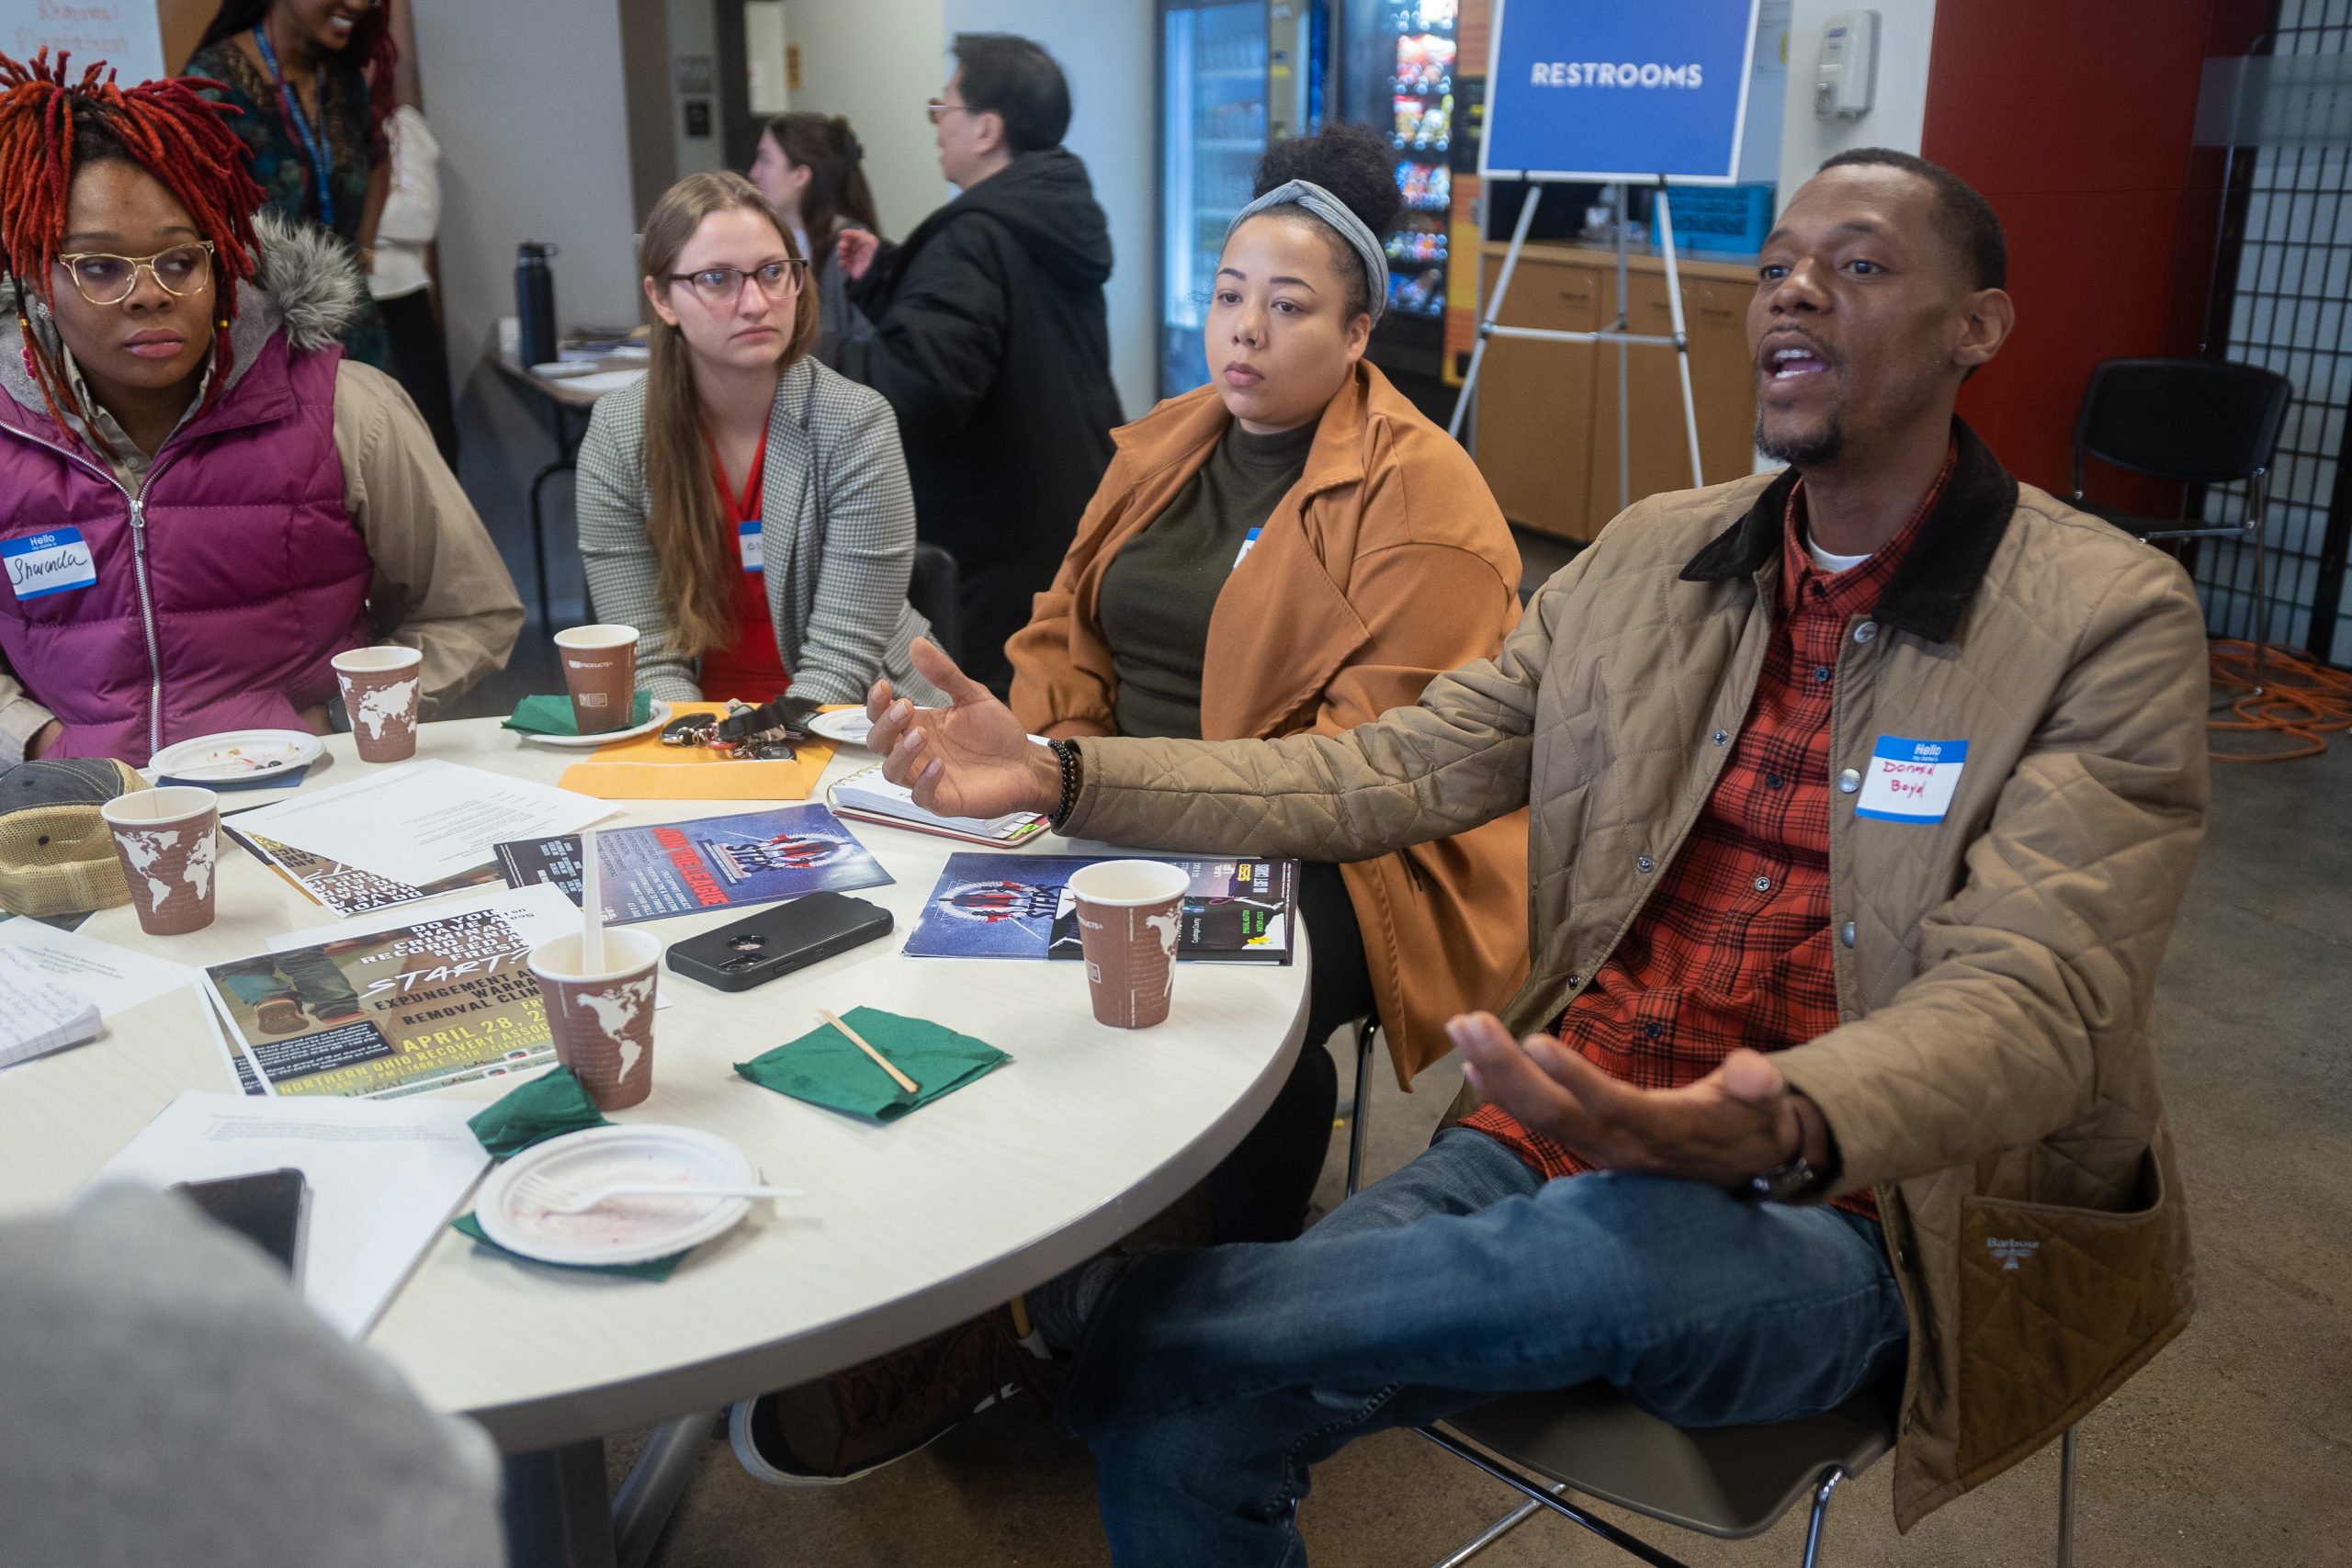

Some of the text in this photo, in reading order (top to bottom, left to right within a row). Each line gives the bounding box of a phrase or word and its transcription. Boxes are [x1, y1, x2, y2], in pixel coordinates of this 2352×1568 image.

[1530, 62, 1702, 88] RESTROOMS
[29, 535, 55, 547] Hello
[1914, 743, 1941, 756] Hello
[1891, 779, 1927, 798] Boyd
[652, 828, 688, 849] JOIN
[668, 847, 706, 869] THE
[391, 889, 424, 901] DO
[680, 866, 731, 907] LEAGUE
[410, 920, 444, 933] DO
[454, 908, 499, 924] YOU
[415, 915, 504, 939] HAVE A
[360, 929, 520, 964] RECORD AND
[393, 921, 514, 950] CRIMINAL
[434, 938, 499, 957] NEED
[448, 942, 530, 962] FRESH
[373, 973, 510, 1010] EXPUNGEMENT
[471, 977, 539, 999] WARRA
[401, 999, 493, 1025] REMOVAL
[496, 987, 540, 1004] CLIN
[401, 1027, 476, 1054] APRIL
[278, 1066, 369, 1095] NORTHERN
[372, 1055, 412, 1073] OHIO
[415, 1035, 494, 1063] RECOVERY
